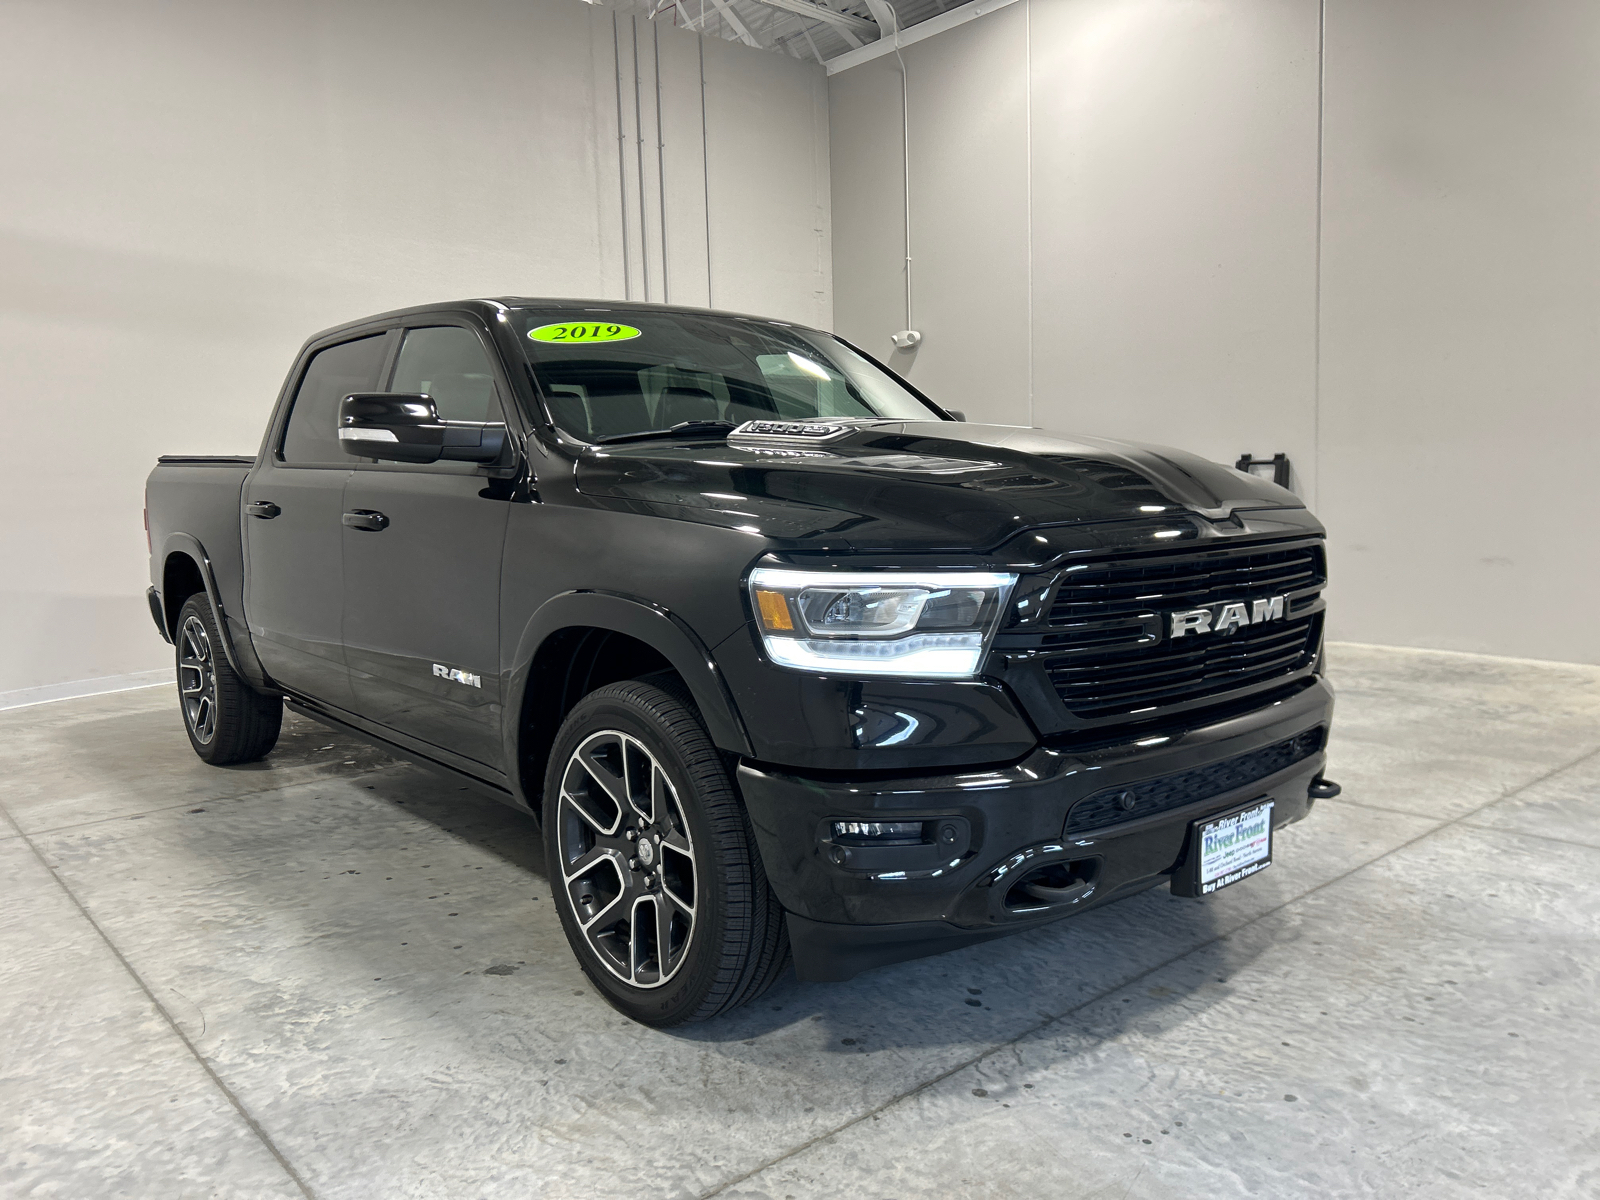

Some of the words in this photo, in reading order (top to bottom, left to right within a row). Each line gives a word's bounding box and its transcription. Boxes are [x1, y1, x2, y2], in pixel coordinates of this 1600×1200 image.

[552, 326, 622, 340] 2019
[1170, 596, 1284, 638] RAM
[432, 664, 482, 688] RAM
[1204, 834, 1234, 856] River
[1235, 819, 1265, 843] Front
[1203, 883, 1216, 894] Buy
[1217, 878, 1224, 888] At
[1225, 872, 1240, 885] River
